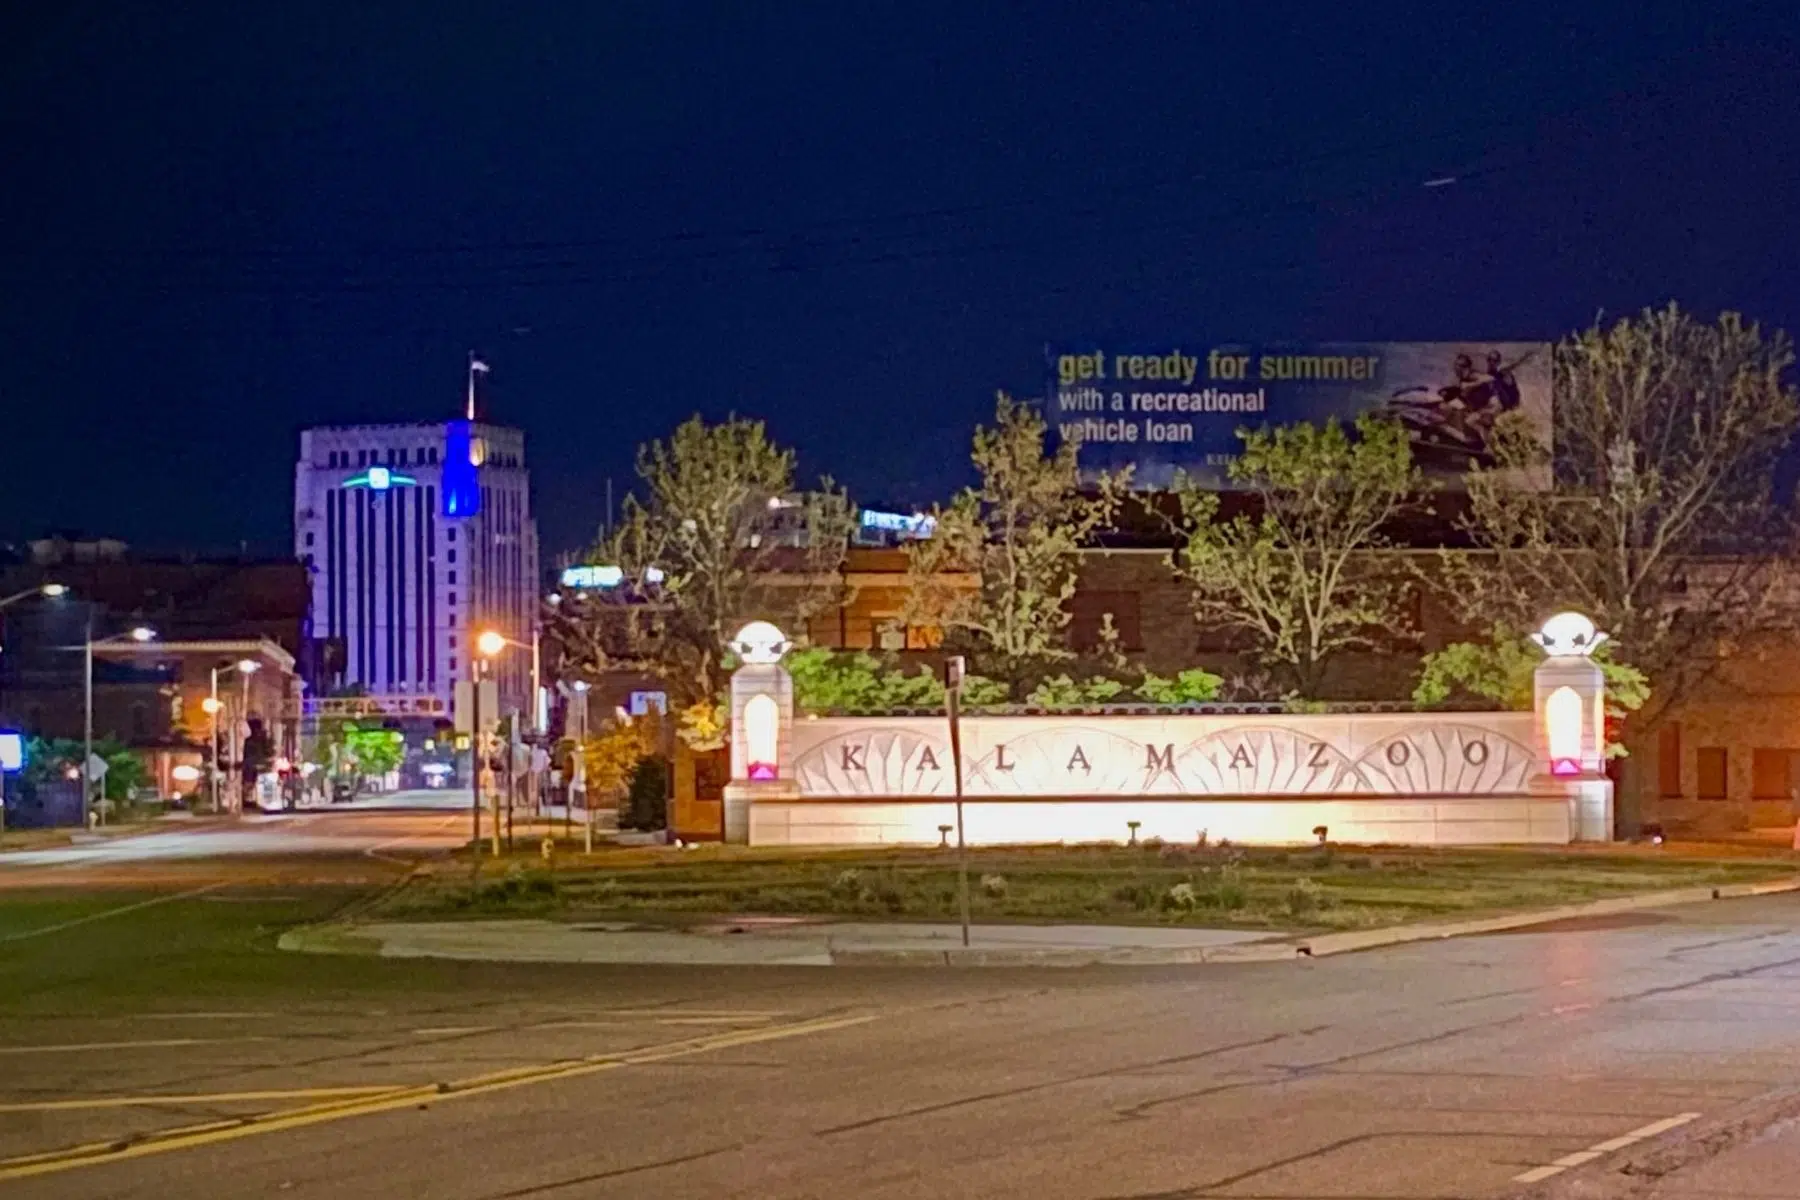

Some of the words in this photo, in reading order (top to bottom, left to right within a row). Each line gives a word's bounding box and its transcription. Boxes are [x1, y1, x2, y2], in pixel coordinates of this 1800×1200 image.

[1059, 351, 1105, 385] get
[1116, 350, 1197, 385] ready
[1208, 350, 1249, 379] for
[1260, 356, 1378, 380] summer
[1059, 388, 1103, 411] with
[1111, 392, 1124, 411] a
[1131, 388, 1264, 412] recreational
[1059, 418, 1138, 441] vehicle
[1146, 418, 1193, 441] loan
[841, 741, 1488, 771] KALAMAZOO
